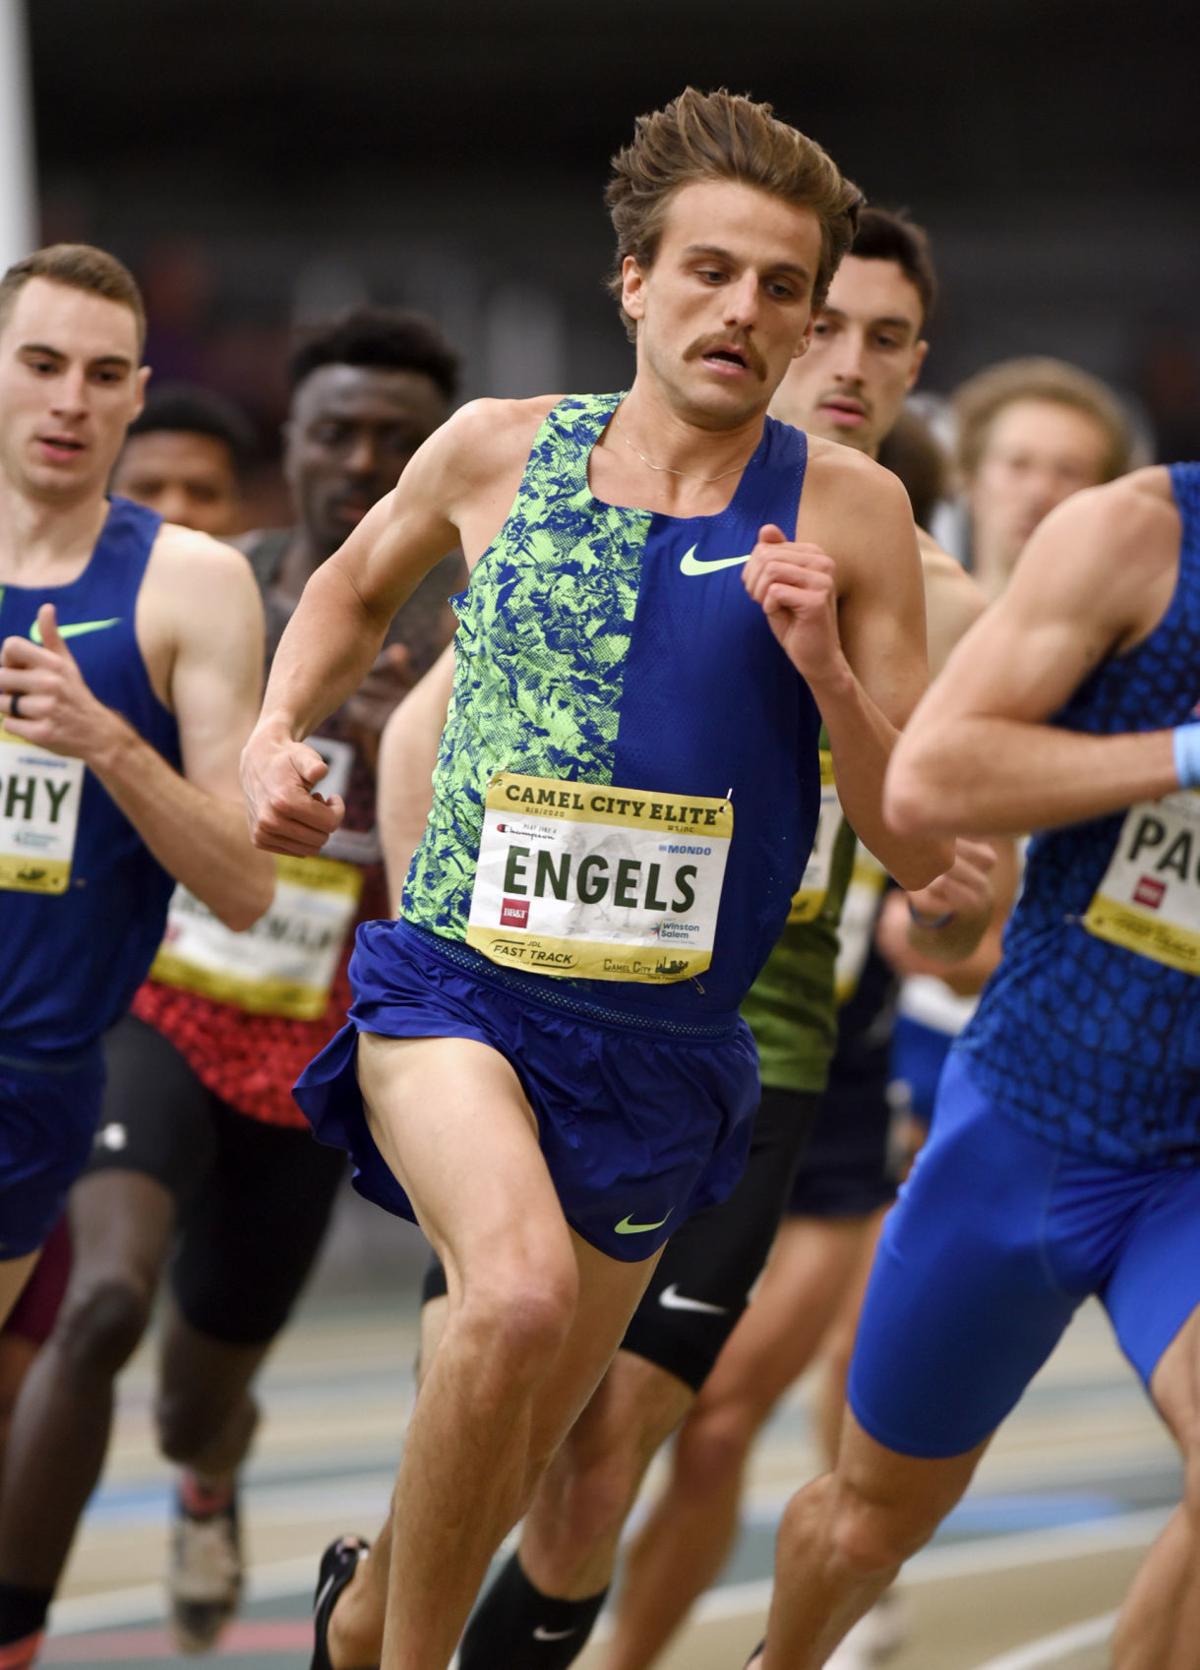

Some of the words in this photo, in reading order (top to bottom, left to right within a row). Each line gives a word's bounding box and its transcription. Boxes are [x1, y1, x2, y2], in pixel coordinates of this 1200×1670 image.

[0, 774, 71, 823] HY
[505, 784, 584, 810] CAMEL
[590, 795, 646, 818] CITY
[649, 803, 717, 825] ELITE
[496, 823, 555, 840] Champion
[667, 845, 712, 856] MONDO
[1128, 814, 1200, 886] PA
[503, 845, 698, 913] ENGELS
[661, 930, 689, 939] Salem
[662, 922, 700, 932] Winston
[527, 940, 542, 948] JDL
[493, 945, 526, 958] FAST
[530, 950, 573, 964] TRACK
